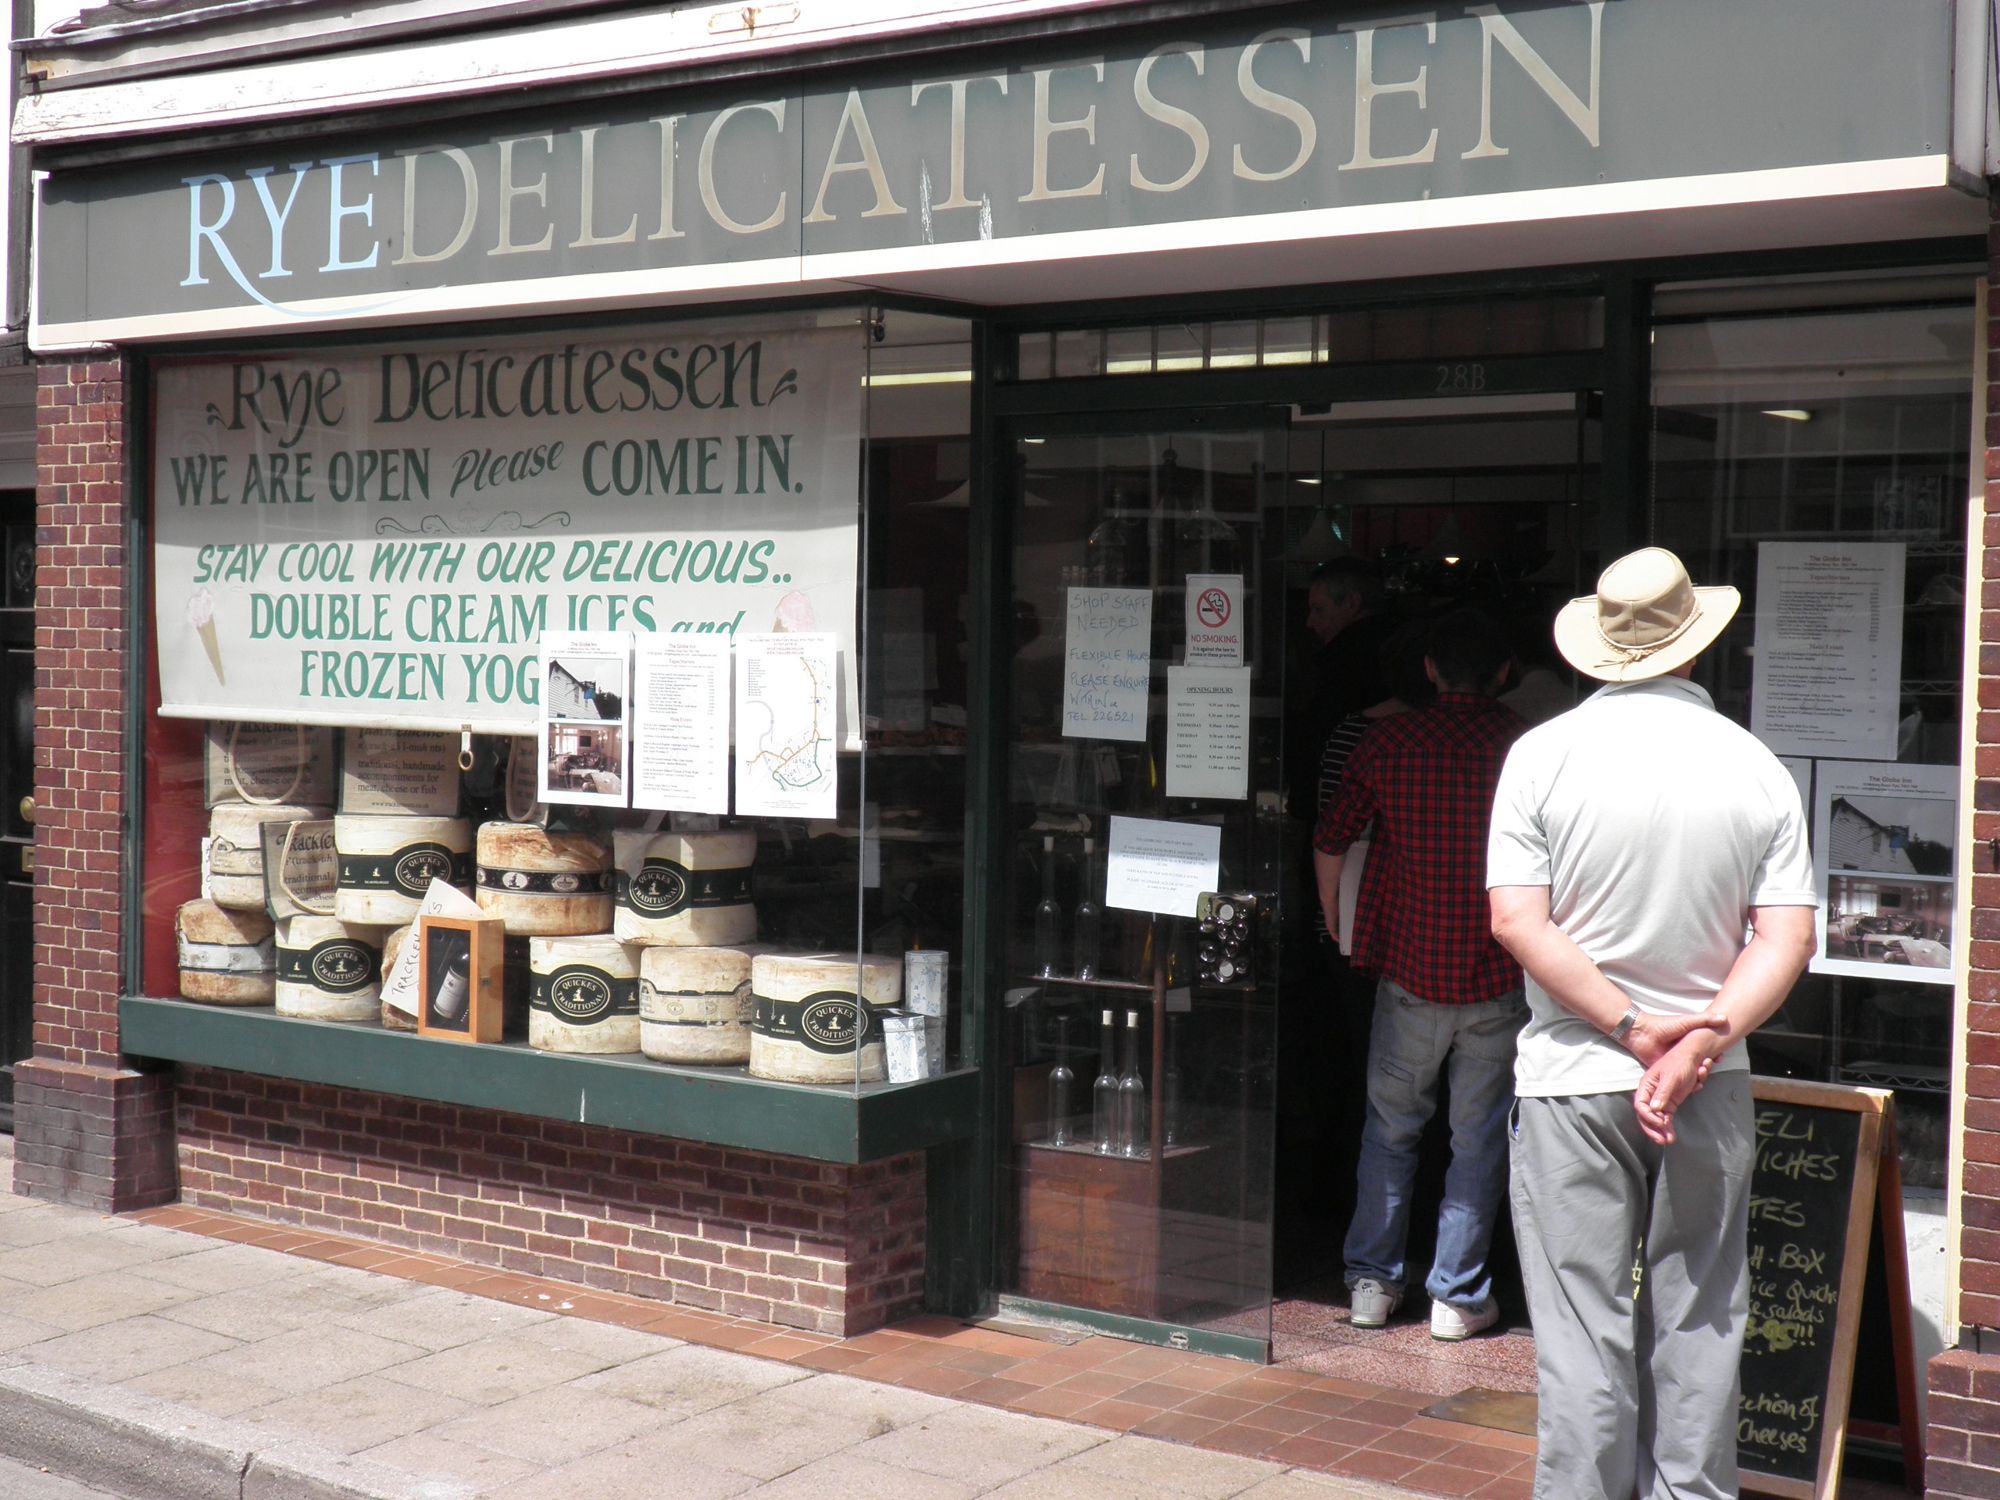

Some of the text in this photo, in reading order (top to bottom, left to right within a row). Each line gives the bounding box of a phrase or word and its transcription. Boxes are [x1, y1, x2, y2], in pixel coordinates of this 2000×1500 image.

[180, 0, 1606, 317] RYE DELICATESSEN
[1435, 363, 1486, 391] 28B
[228, 341, 768, 448] Rye Delicatessen
[170, 434, 803, 506] WE ARE OPEN Please COME IN.
[193, 540, 792, 584] STAY COOL WITH OUR DELICIOUS..
[1070, 592, 1150, 613] SHOP STAFF
[249, 593, 393, 641] DOUBLE
[405, 593, 548, 643] CREAM
[567, 594, 657, 633] ICES
[1077, 615, 1139, 638] NEEDED
[1191, 634, 1202, 643] NO
[1070, 648, 1121, 663] FLEXIBLE
[300, 650, 540, 705] FROZEN YOG
[1070, 671, 1110, 691] PLEASE
[1070, 689, 1109, 710] WITHIN
[1187, 686, 1234, 694] OPENING HOURS
[1067, 712, 1089, 721] TEL
[408, 856, 441, 867] QUICKES
[638, 872, 672, 884] QUICKES
[633, 886, 678, 904] TRADITIONAL
[324, 951, 359, 962] QUICKES
[319, 962, 364, 980] TRADITIONAL
[561, 979, 597, 992] QUICKES
[556, 990, 604, 1010] TRADITIONAL
[815, 1006, 855, 1019] QUICKES
[1754, 1111, 1814, 1142] ELI
[1762, 1303, 1824, 1323] salads
[1799, 1395, 1820, 1432] of
[1737, 1418, 1807, 1454] Cheeses
